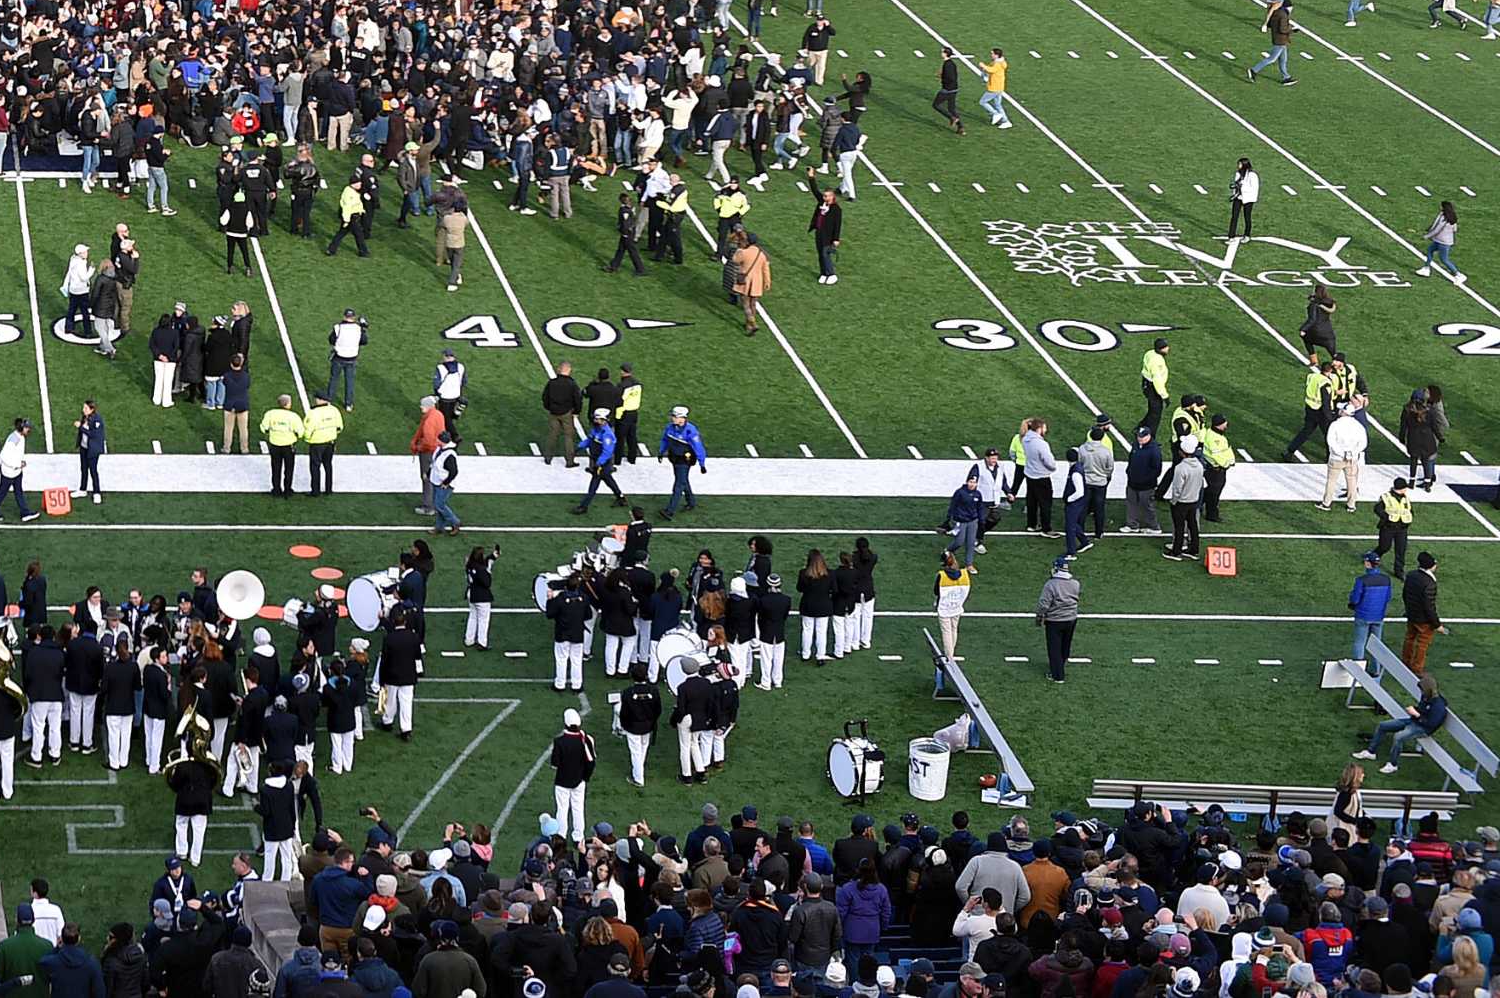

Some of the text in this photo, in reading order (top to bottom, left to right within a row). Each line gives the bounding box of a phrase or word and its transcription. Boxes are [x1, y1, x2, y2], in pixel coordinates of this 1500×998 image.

[1068, 221, 1181, 234] THE
[1082, 235, 1368, 271] IVY
[1112, 269, 1412, 288] LEAGUE
[441, 314, 621, 348] 40
[931, 318, 1121, 352] 30
[49, 490, 66, 507] 50
[1213, 551, 1231, 568] 30
[909, 757, 930, 778] ST
